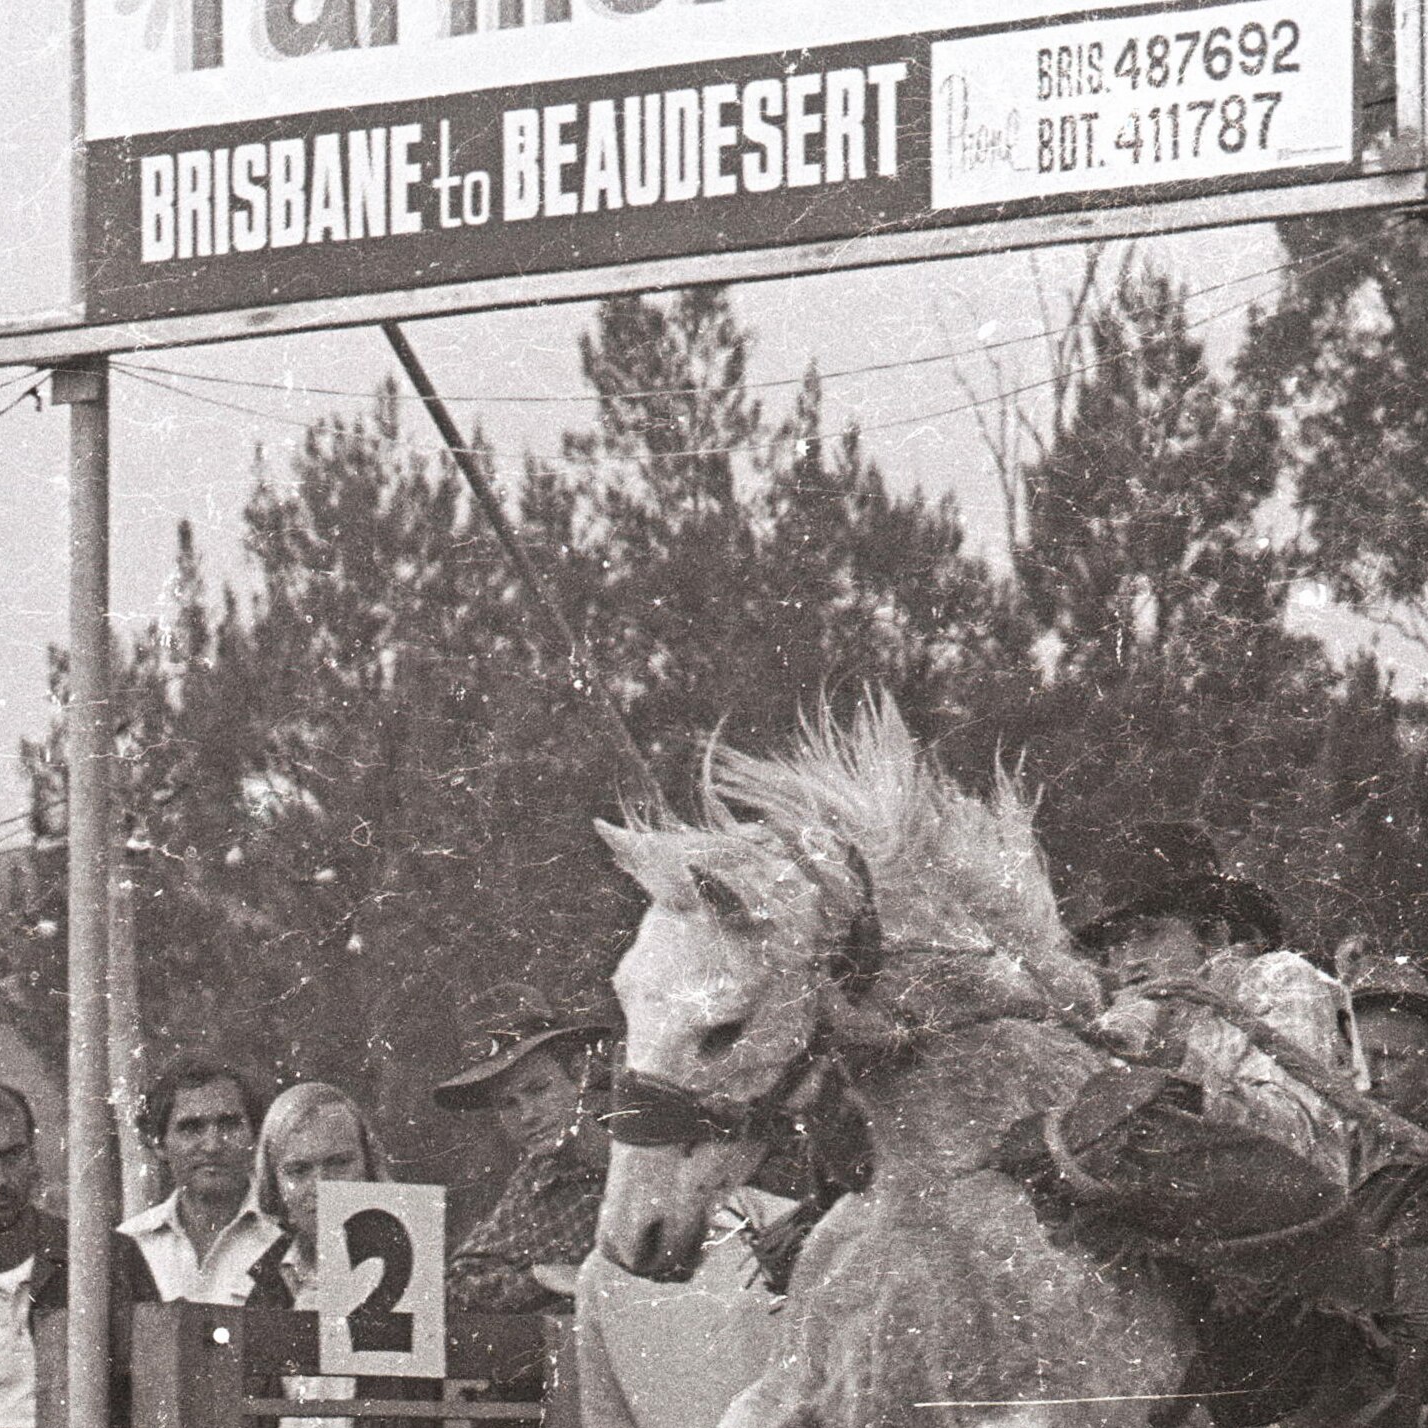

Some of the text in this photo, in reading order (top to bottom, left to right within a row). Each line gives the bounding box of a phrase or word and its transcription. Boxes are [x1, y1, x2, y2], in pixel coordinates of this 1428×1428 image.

[1037, 19, 1301, 101] BRIS. 487692
[141, 62, 908, 263] BRISBANE to BEAUDESERT
[1038, 91, 1283, 174] BDT. 411787
[343, 1208, 414, 1352] 2
